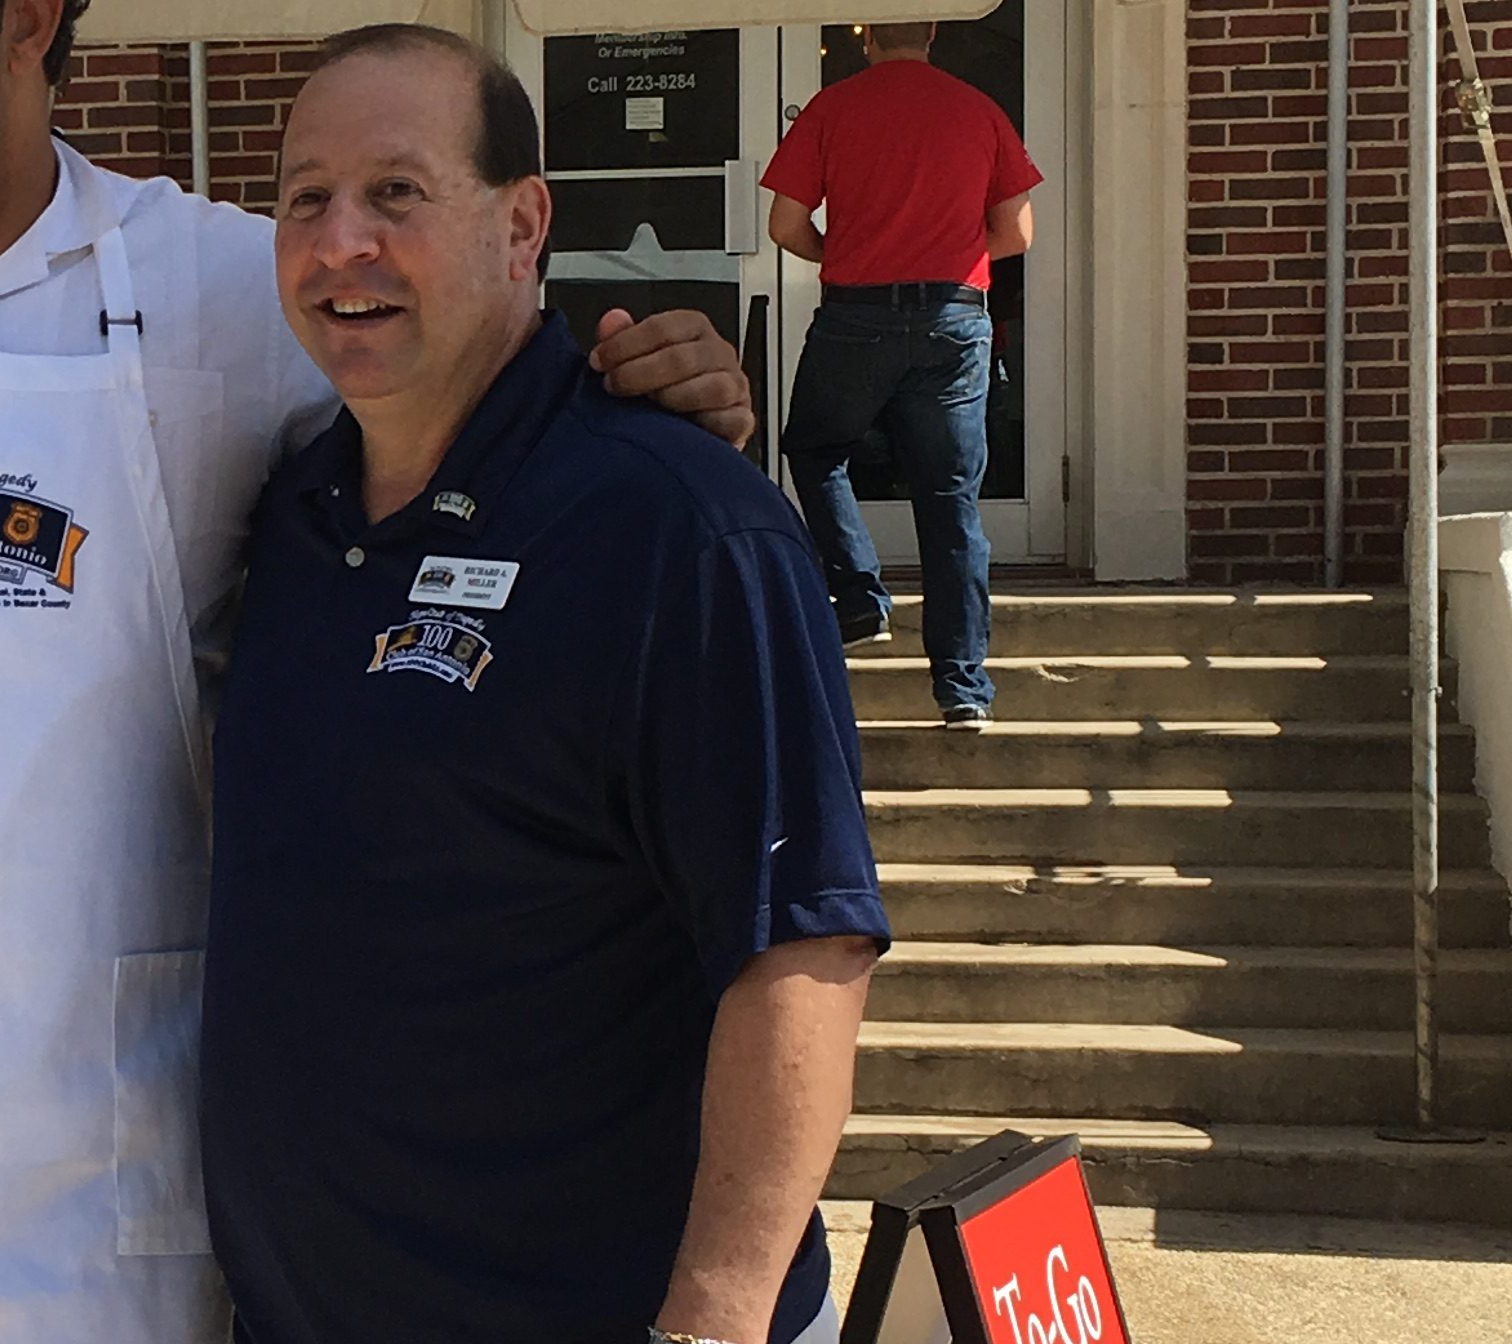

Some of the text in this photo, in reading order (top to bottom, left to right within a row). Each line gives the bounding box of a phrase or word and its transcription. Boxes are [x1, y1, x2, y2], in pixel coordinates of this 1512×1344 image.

[598, 44, 685, 60] Or Emergencies
[588, 73, 696, 93] Call 223-8284
[417, 624, 454, 651] 100
